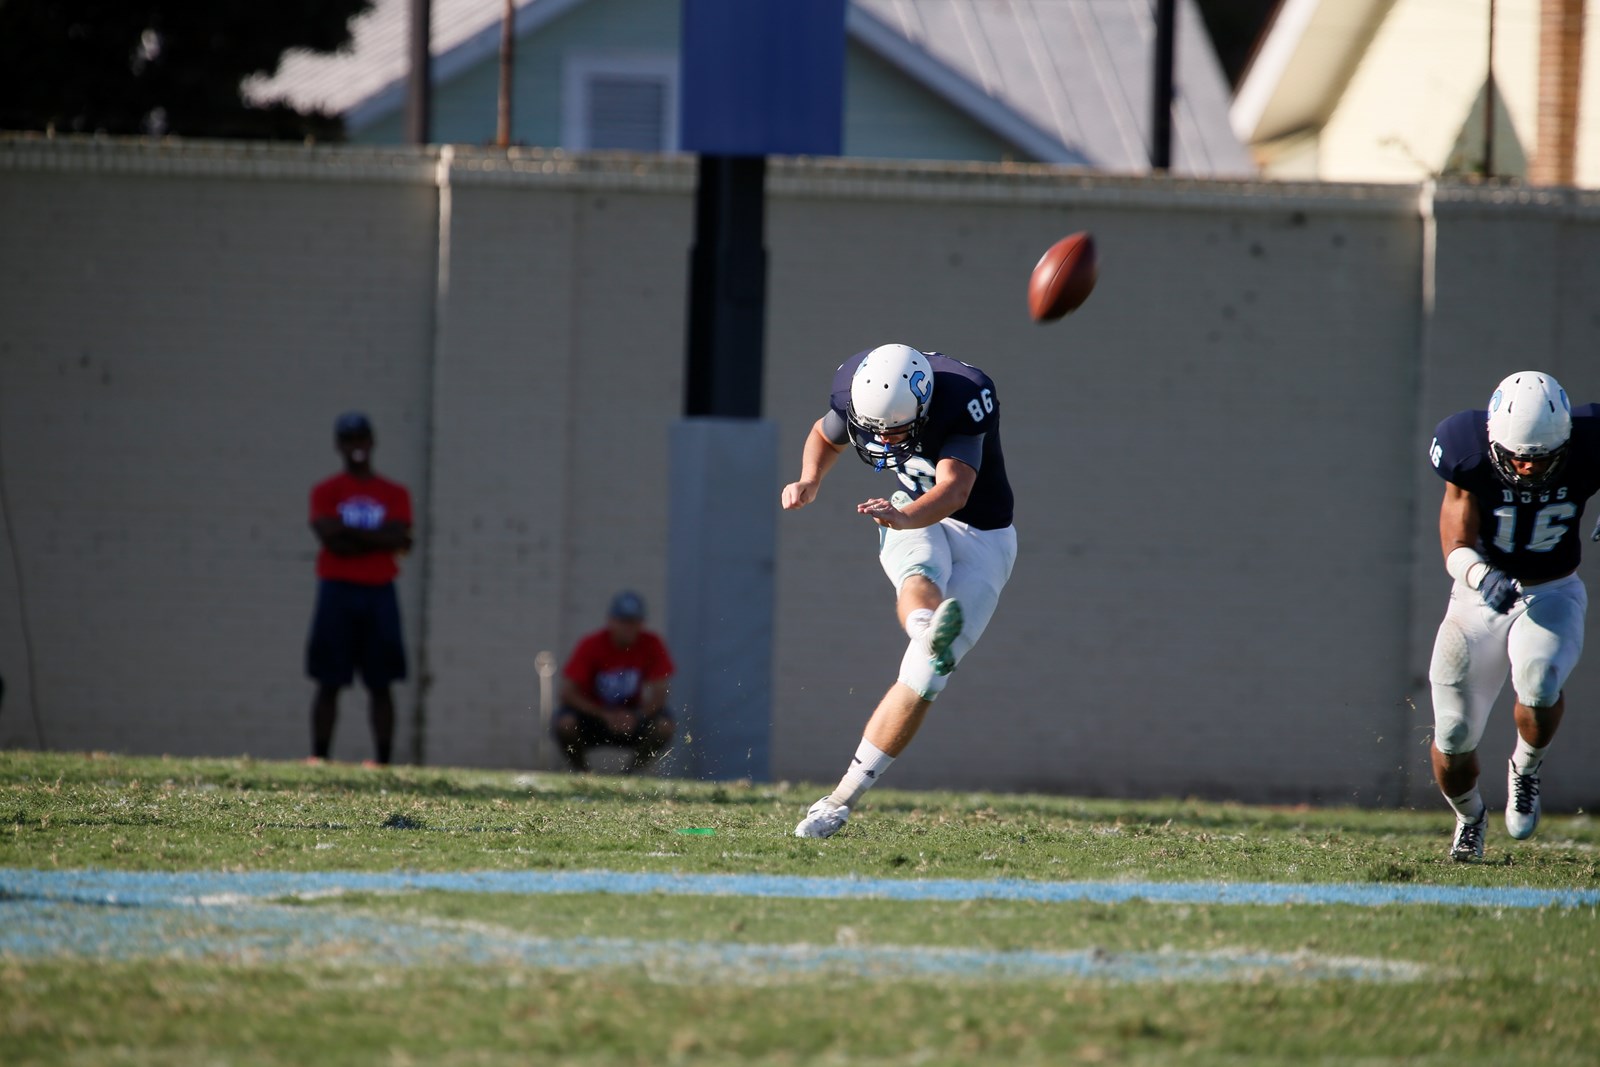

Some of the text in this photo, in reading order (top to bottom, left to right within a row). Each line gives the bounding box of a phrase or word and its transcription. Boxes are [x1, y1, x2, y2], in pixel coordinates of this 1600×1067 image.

[909, 370, 932, 404] C
[967, 388, 994, 423] 86
[1429, 436, 1443, 468] 16
[1502, 487, 1568, 504] DOGS
[1493, 502, 1577, 553] 16
